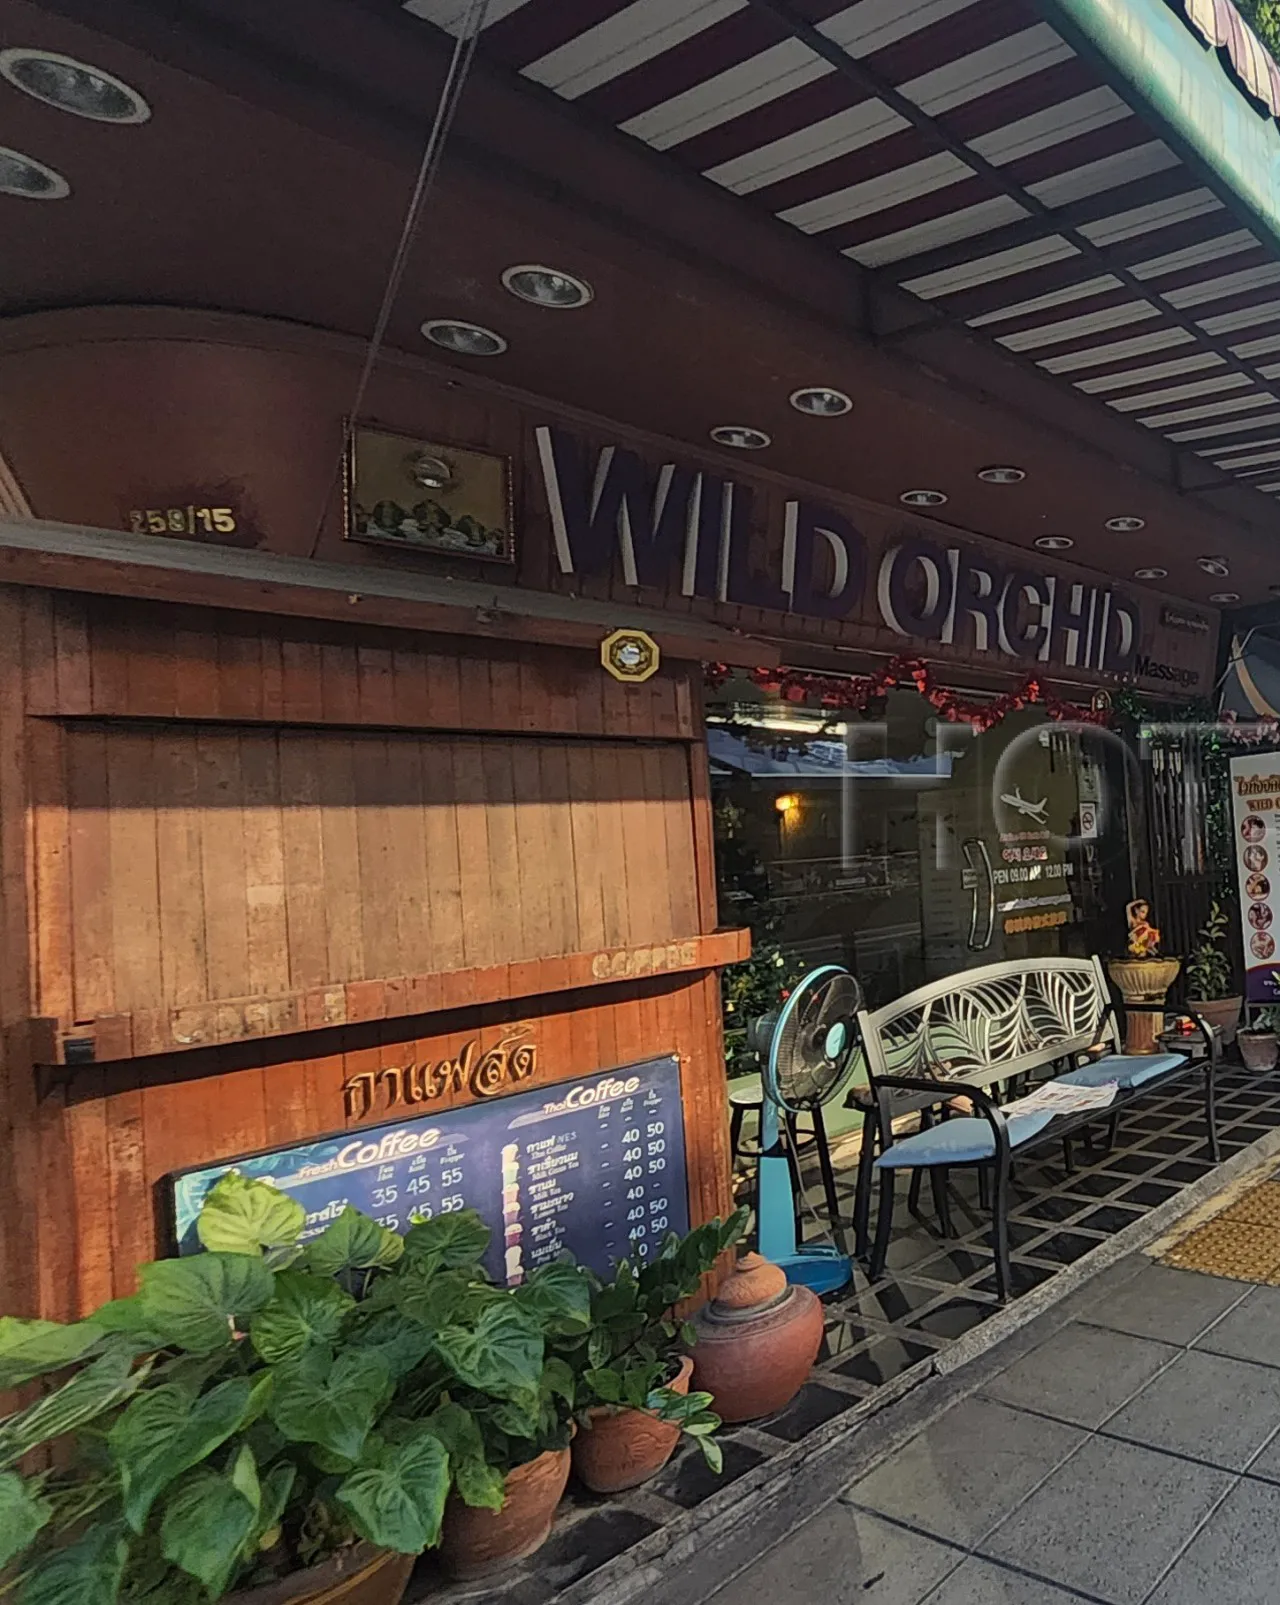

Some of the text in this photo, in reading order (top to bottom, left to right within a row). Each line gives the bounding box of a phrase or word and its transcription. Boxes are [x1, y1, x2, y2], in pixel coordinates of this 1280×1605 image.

[535, 425, 1142, 680] WILD ORCHID
[1135, 653, 1200, 688] Massage
[341, 1034, 537, 1121] กาแฟสด
[543, 1100, 566, 1115] Thai
[565, 1075, 642, 1109] Coffee
[526, 1131, 577, 1154] กาแฟ NES
[621, 1122, 665, 1143] 40 50
[296, 1127, 442, 1180] Fresh Coffee
[623, 1139, 666, 1163] 40 50
[624, 1158, 666, 1181] 40 50
[371, 1167, 463, 1208] 35 45 55
[528, 1178, 557, 1195] ชานม
[550, 1187, 562, 1197] Tea
[626, 1185, 645, 1200] 40
[440, 1194, 464, 1214] 55
[627, 1198, 668, 1221] 40 50
[530, 1217, 557, 1237] ชาดำ
[628, 1216, 669, 1241] 40 50
